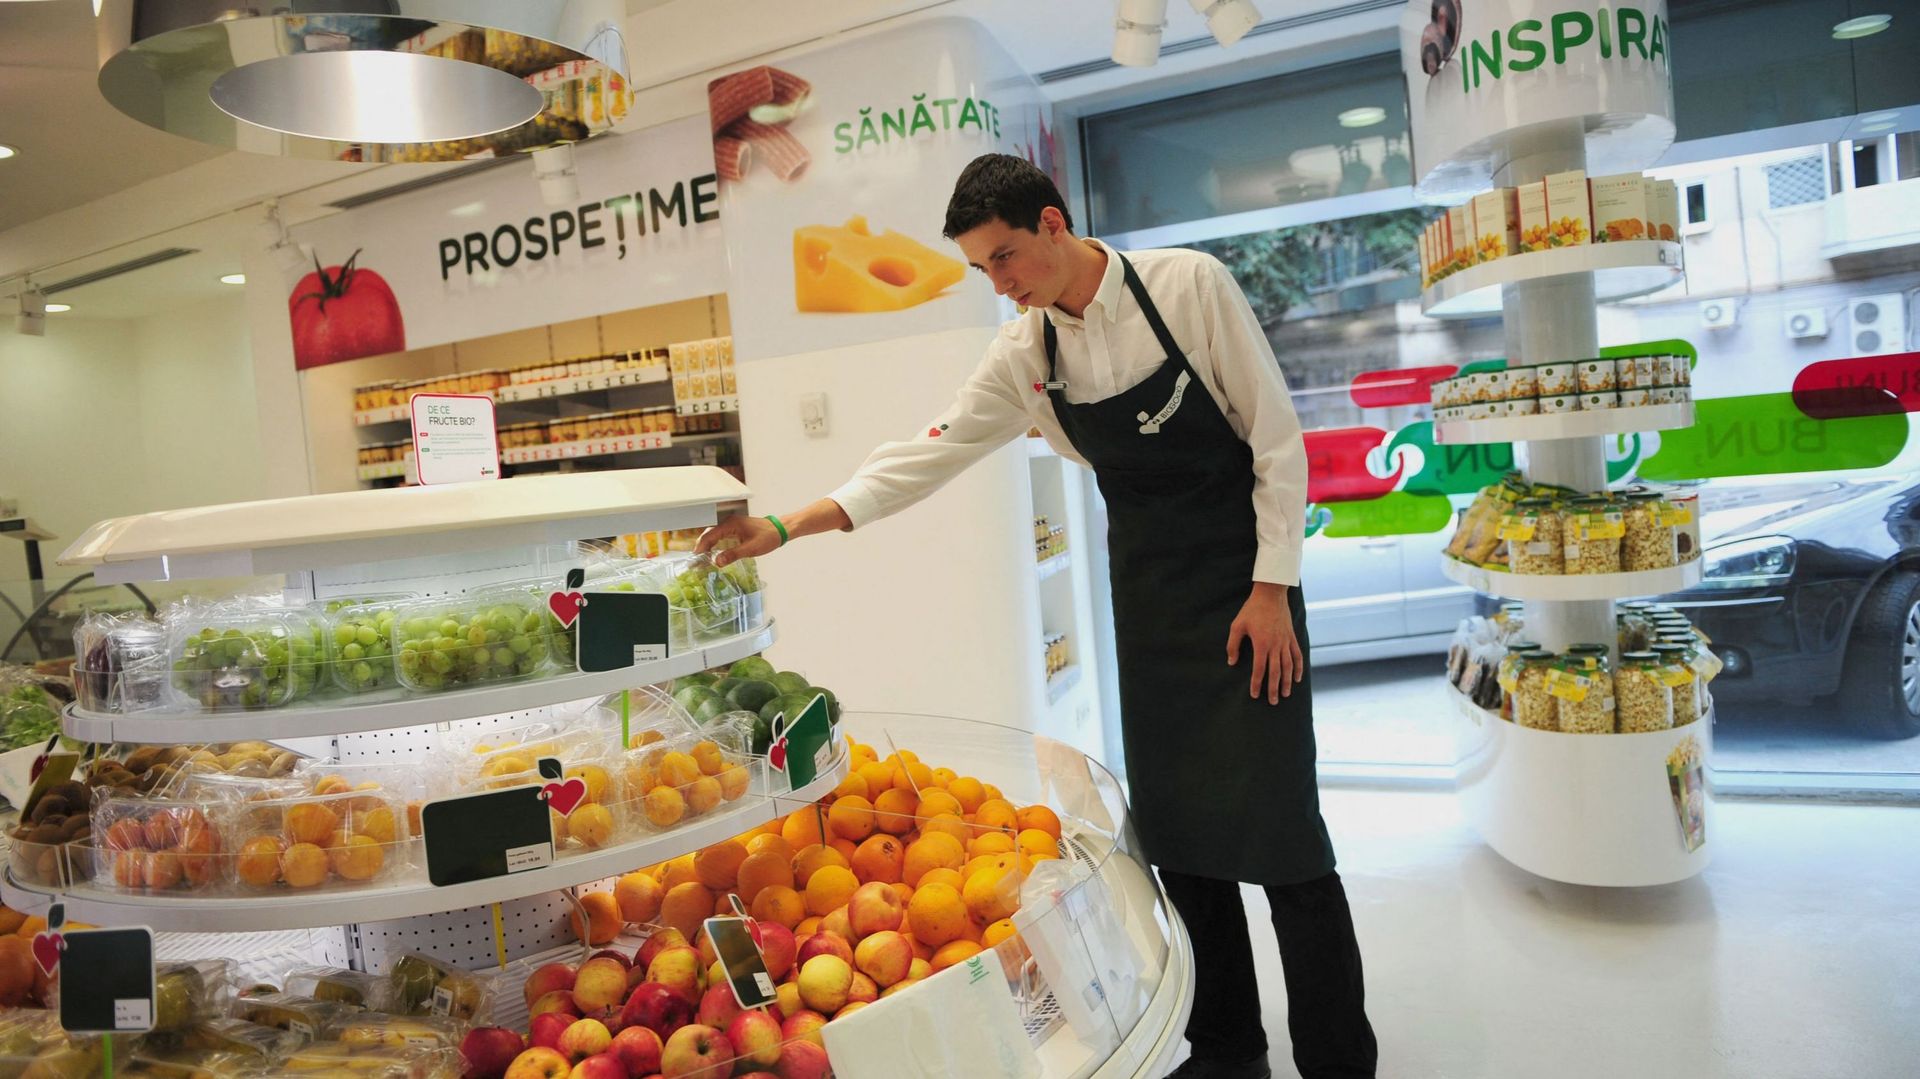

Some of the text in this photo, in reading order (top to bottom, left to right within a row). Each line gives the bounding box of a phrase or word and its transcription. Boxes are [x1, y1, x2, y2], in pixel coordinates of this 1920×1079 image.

[834, 92, 1001, 153] SĂNĂTATE
[439, 173, 720, 280] PROSPEȚIME
[427, 405, 451, 415] DE CE
[428, 416, 476, 426] FRUCTE BIO?
